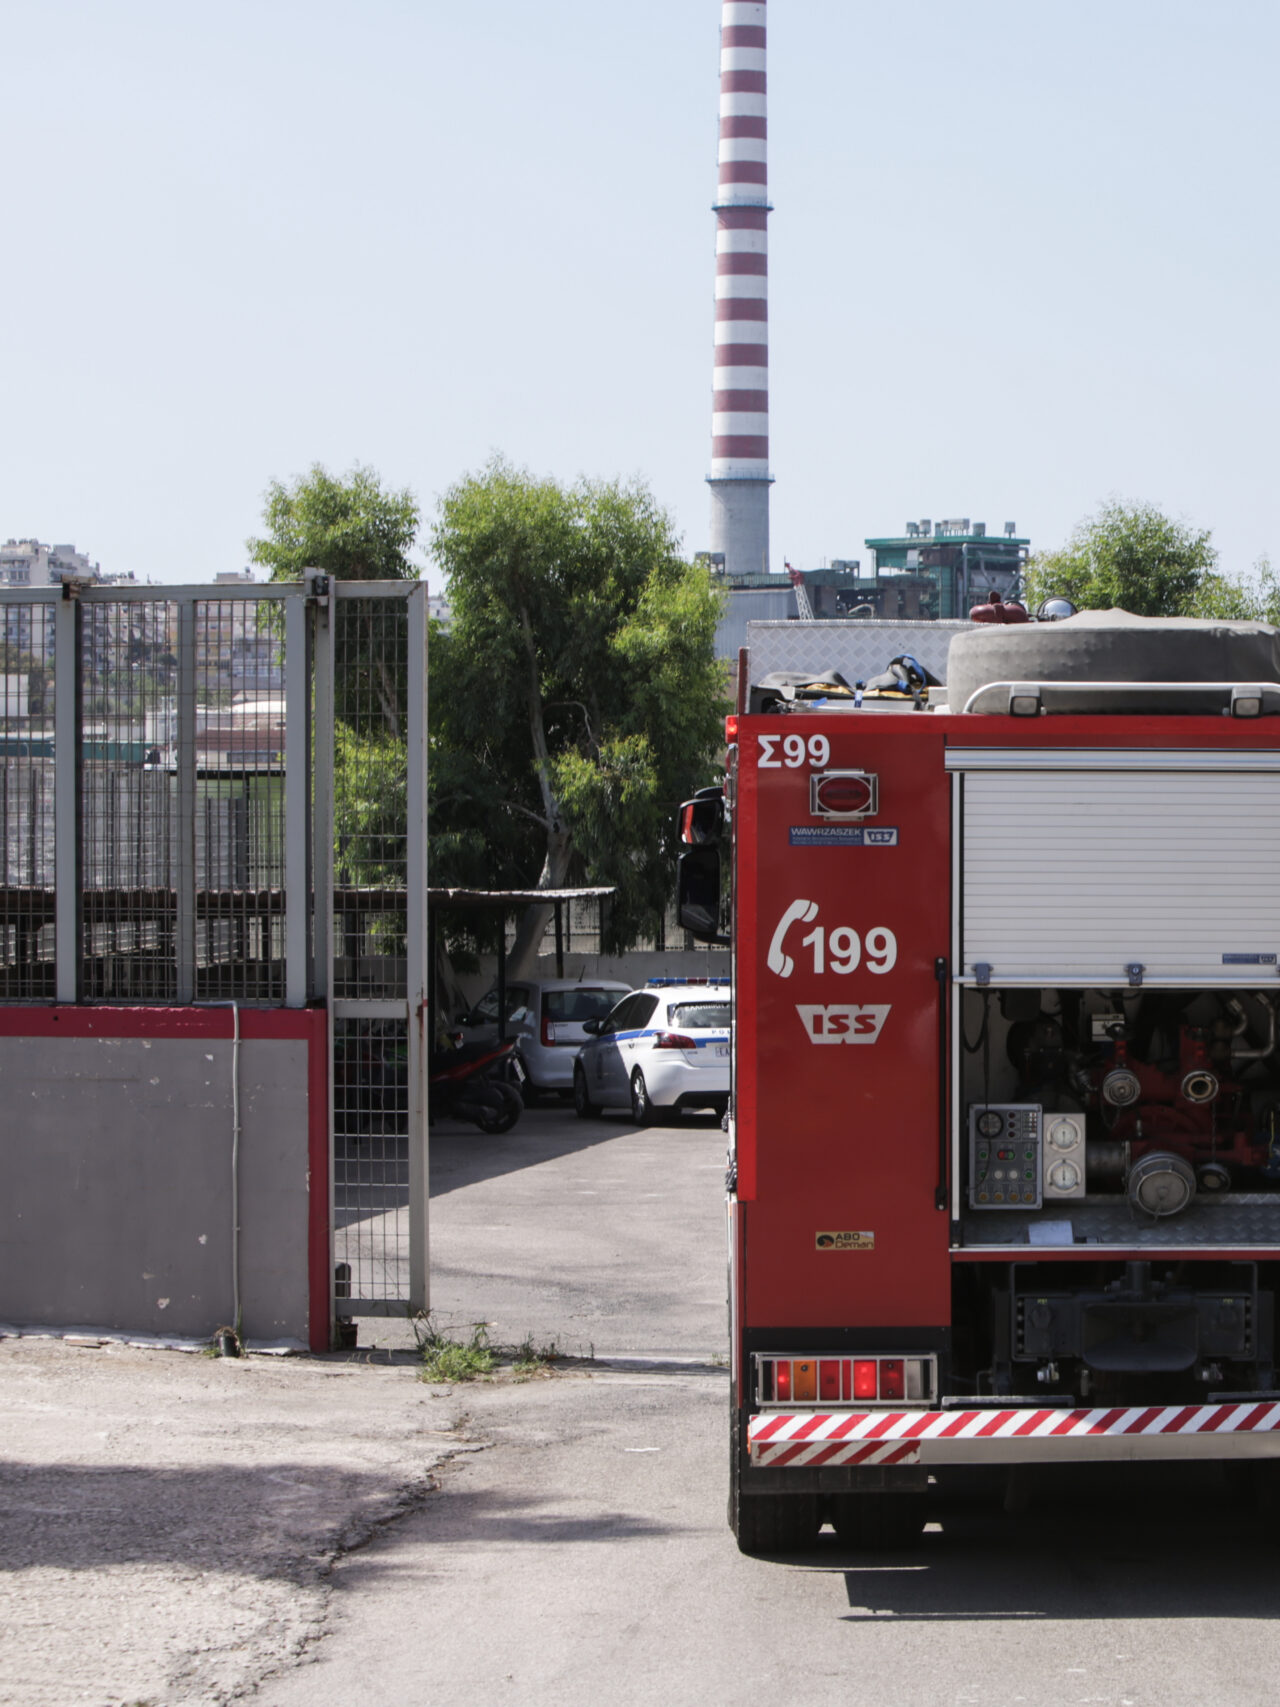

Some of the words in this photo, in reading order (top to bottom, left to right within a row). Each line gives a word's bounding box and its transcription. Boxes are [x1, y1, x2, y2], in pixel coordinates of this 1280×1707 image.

[758, 734, 830, 768] Σ99
[802, 926, 897, 974] 199
[812, 1013, 877, 1035] ISS
